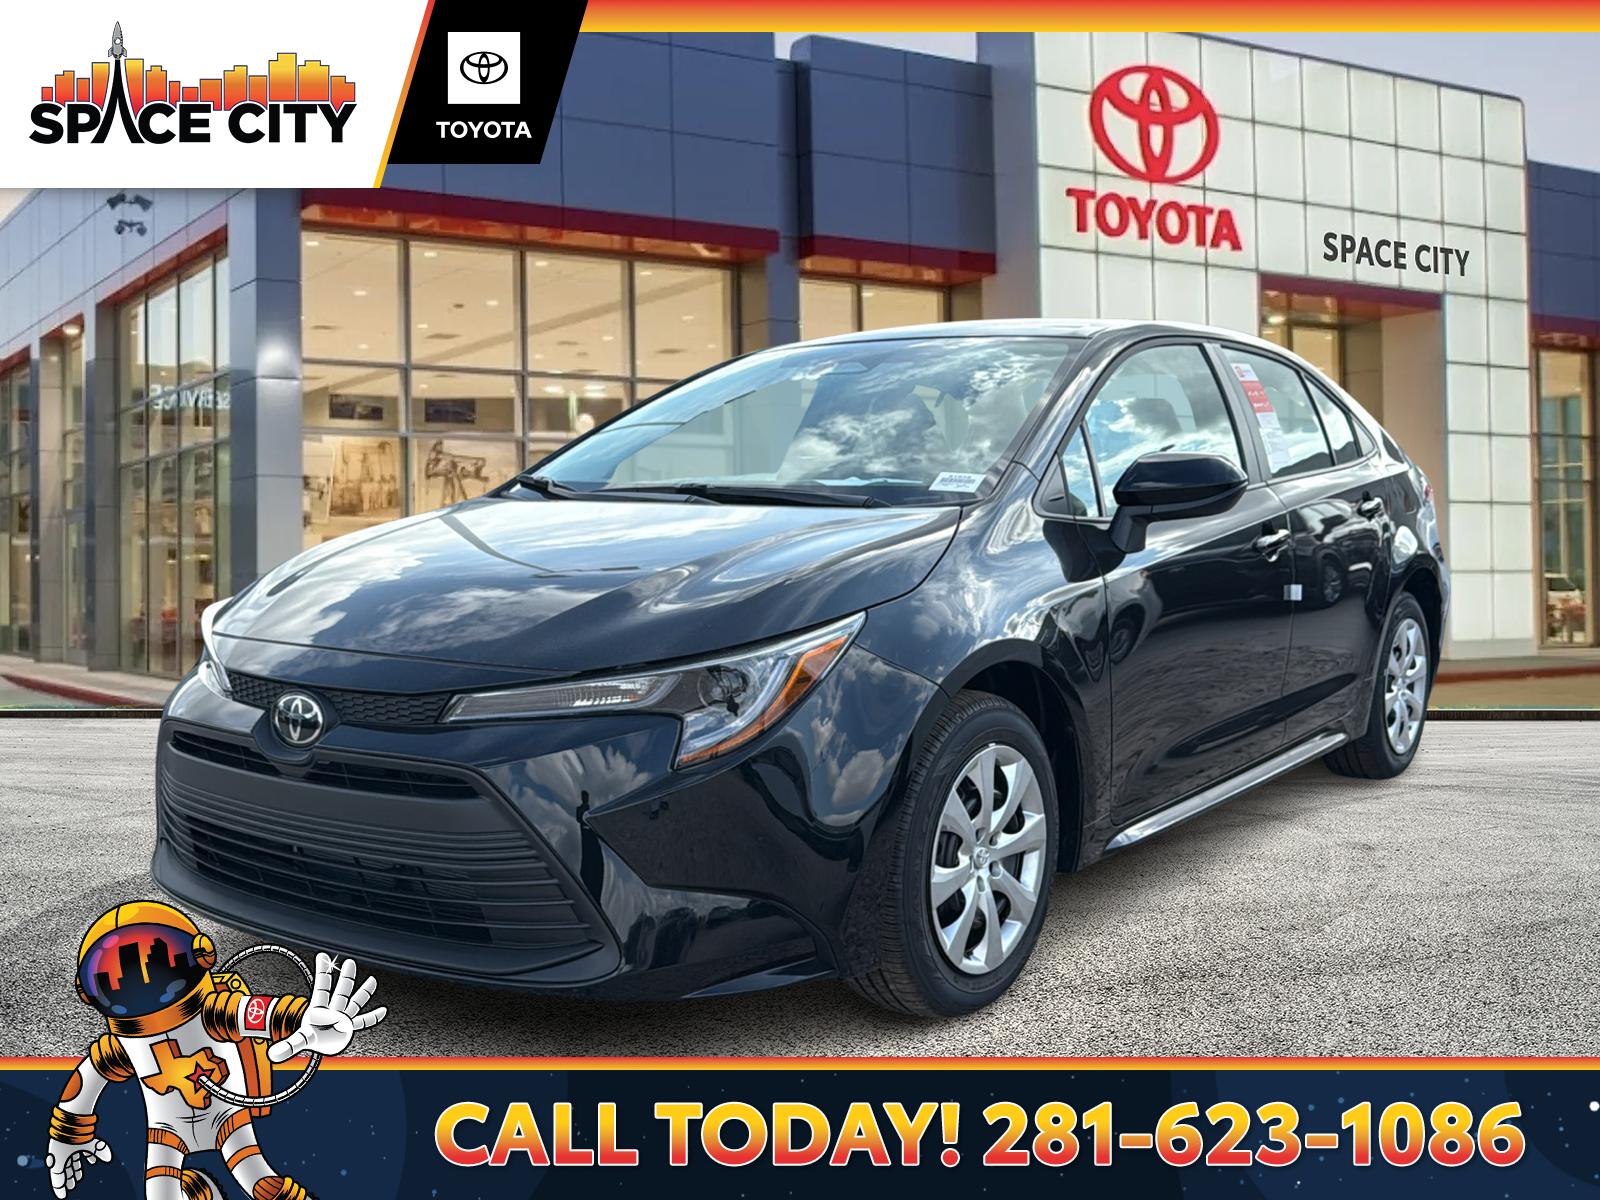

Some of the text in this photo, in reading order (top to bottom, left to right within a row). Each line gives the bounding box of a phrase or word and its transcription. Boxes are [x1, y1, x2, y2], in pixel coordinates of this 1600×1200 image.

[1066, 187, 1242, 251] TOYOTA
[1323, 231, 1470, 278] SPACE CITY
